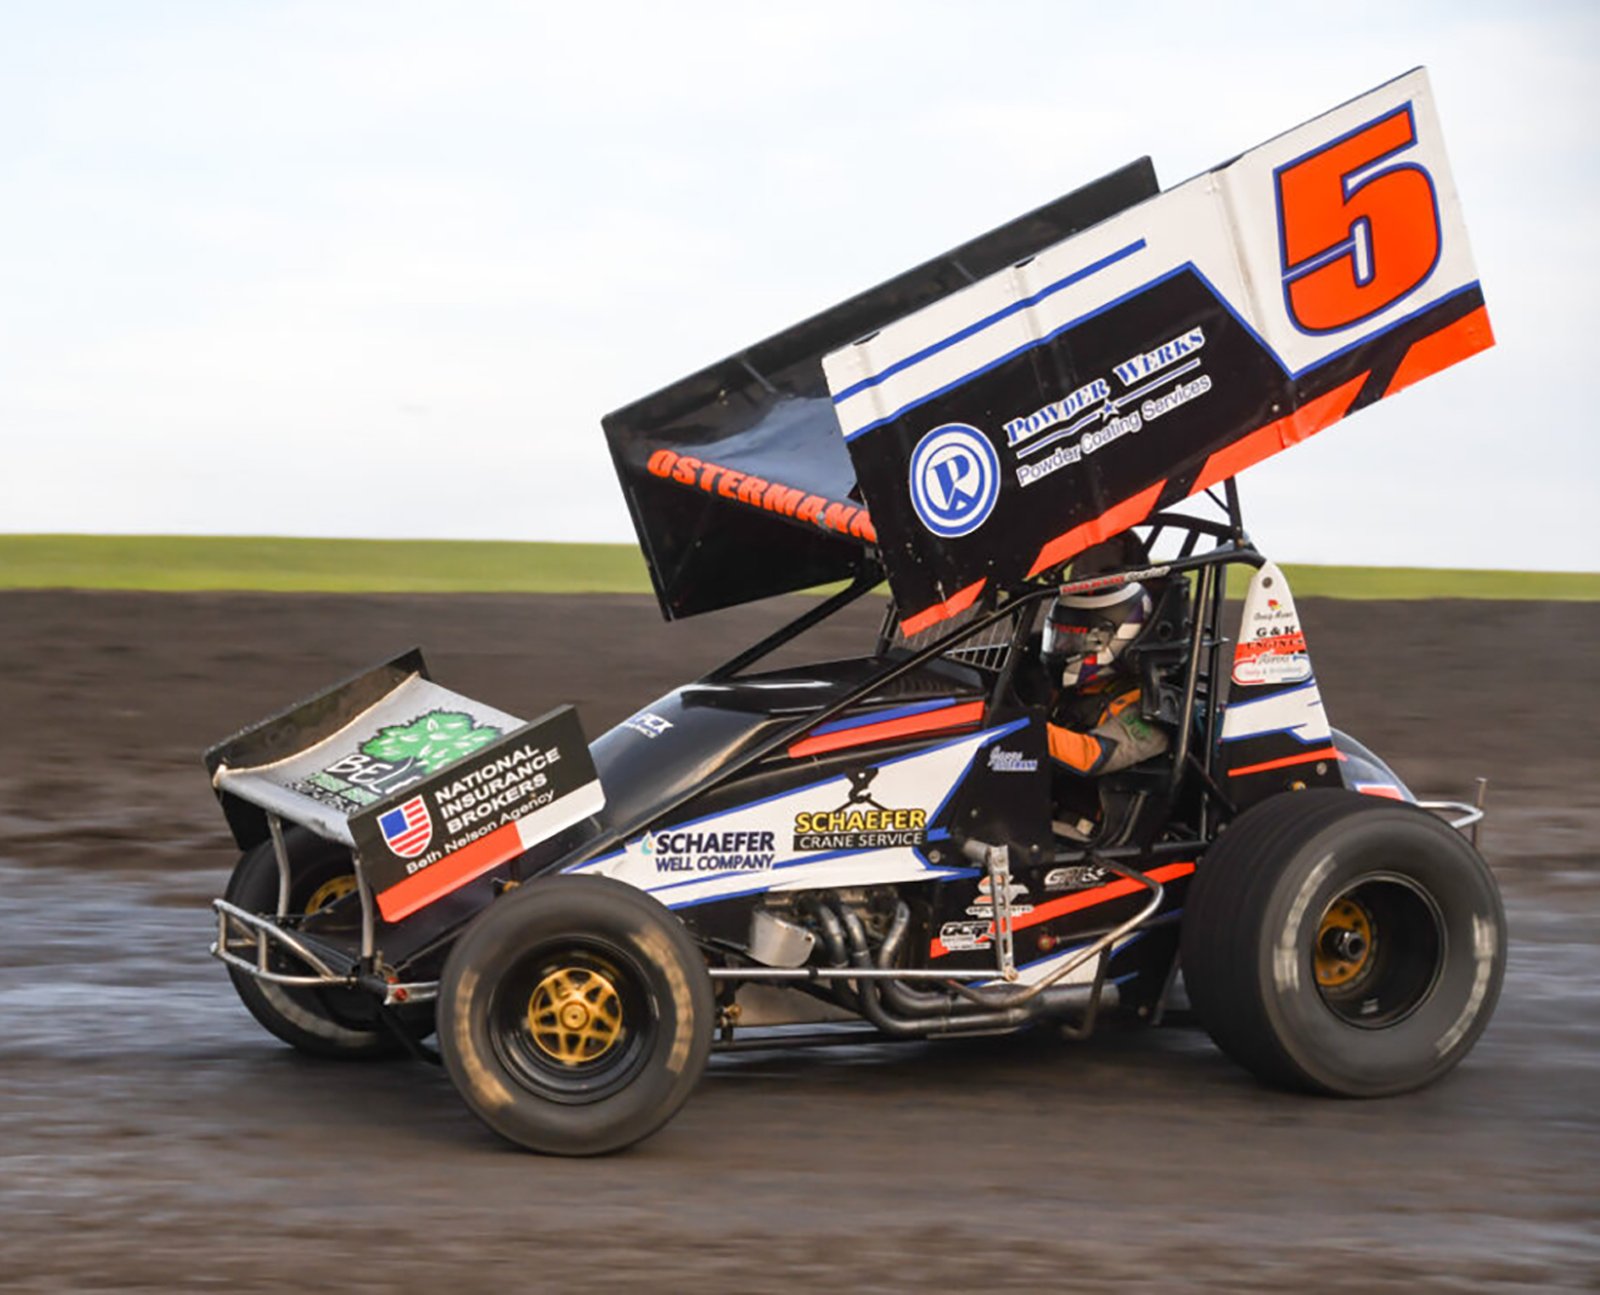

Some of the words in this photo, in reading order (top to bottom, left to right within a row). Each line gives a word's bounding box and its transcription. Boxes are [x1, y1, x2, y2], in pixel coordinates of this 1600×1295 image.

[1272, 100, 1443, 337] 5
[1003, 379, 1110, 447] POWDER
[1113, 327, 1206, 387] WERKS
[1016, 447, 1081, 487] Powder
[1081, 411, 1142, 455] Coating
[1141, 374, 1212, 421] Services
[647, 449, 877, 543] OSTERMANN
[434, 744, 540, 803] NATIONAL
[440, 747, 561, 820] INSURANCE
[446, 773, 548, 834] BROKERS
[405, 849, 442, 875] Beth
[444, 820, 498, 853] Nelson
[500, 789, 555, 825] Agency
[655, 831, 775, 855] SCHAEFER
[795, 809, 927, 833] SCHAEFER
[799, 836, 853, 849] CRANE
[858, 832, 922, 847] SERVICE
[655, 856, 694, 872] WELL
[697, 854, 775, 871] COMPANY
